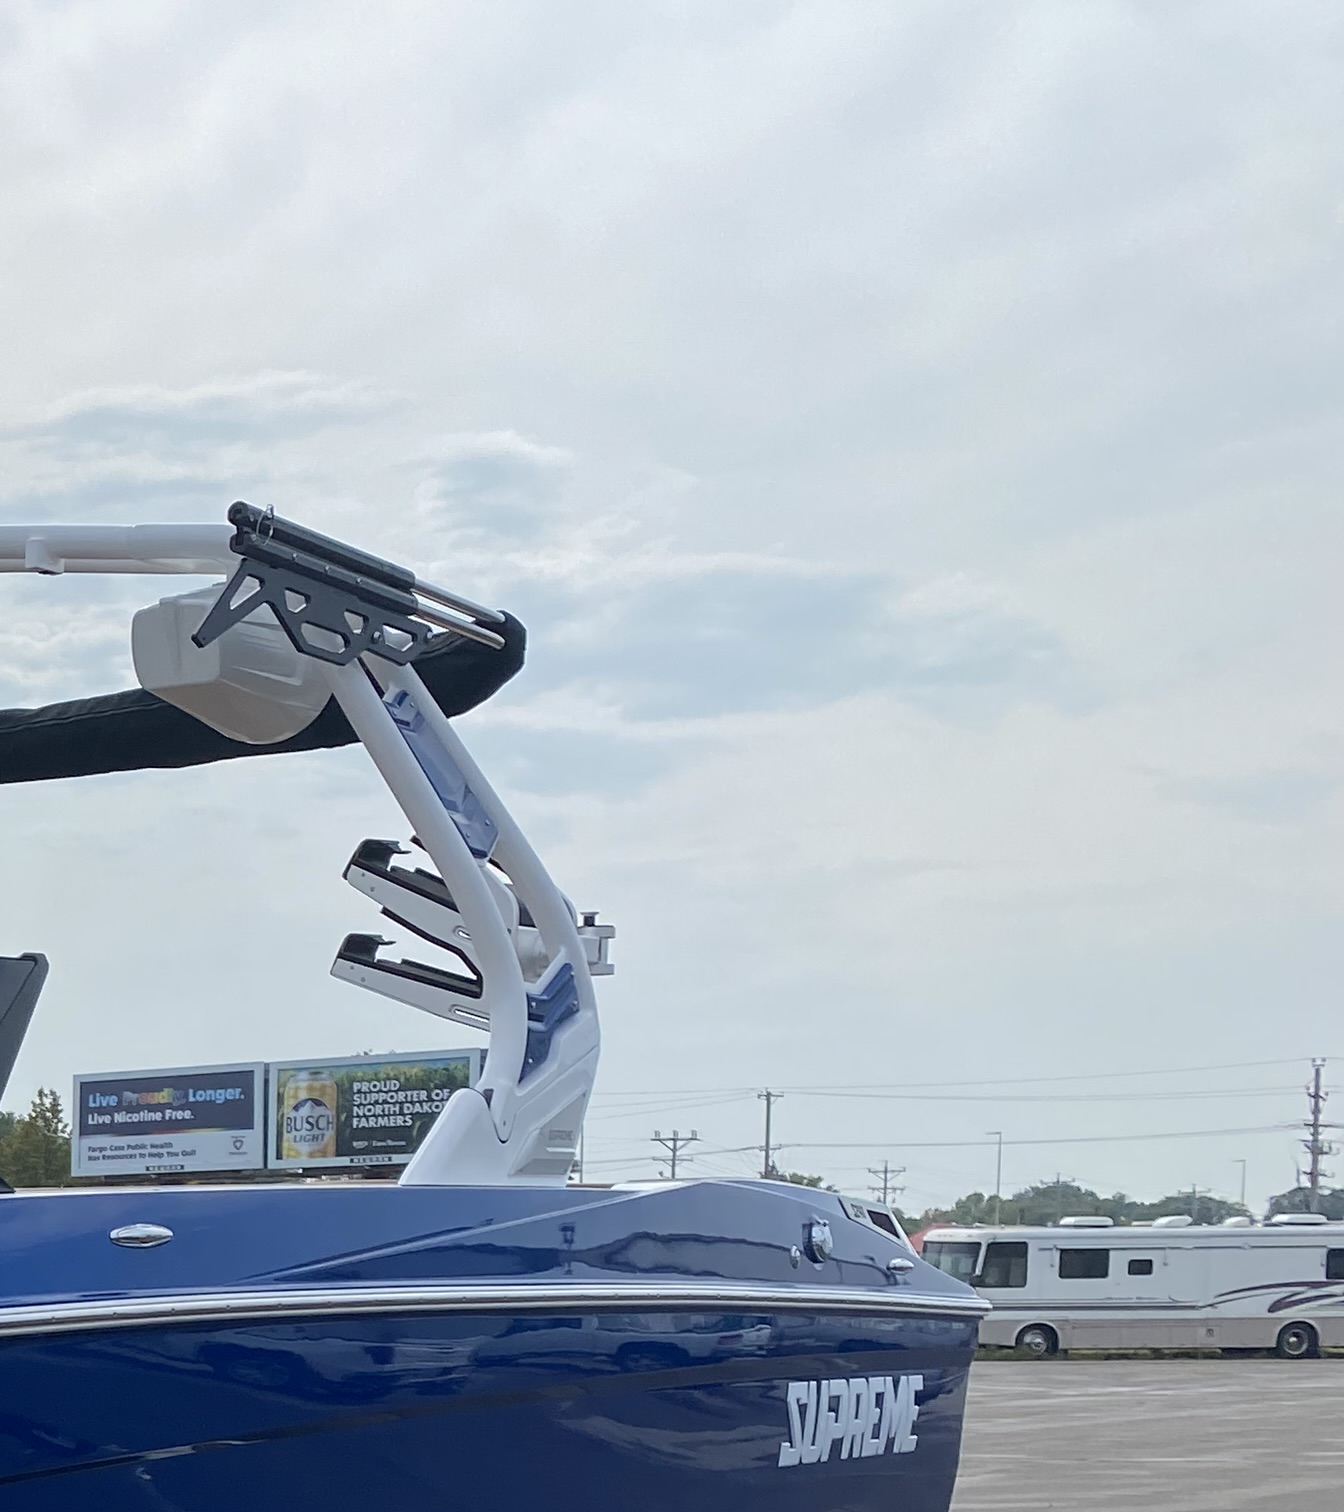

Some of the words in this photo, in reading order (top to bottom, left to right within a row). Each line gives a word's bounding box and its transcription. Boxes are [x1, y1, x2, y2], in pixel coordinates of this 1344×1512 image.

[353, 1080, 400, 1093] PROUD
[88, 1093, 118, 1107] Live
[188, 1087, 245, 1104] Longer.
[353, 1090, 428, 1104] SUPPORTER
[431, 1088, 450, 1101] OF
[353, 1104, 400, 1116] NORTH
[403, 1101, 449, 1114] DAKO
[88, 1113, 111, 1125] Live
[114, 1110, 162, 1123] Nicotine
[165, 1109, 195, 1121] Free.
[286, 1114, 334, 1134] BUSCH
[353, 1115, 413, 1128] FARMERS
[293, 1133, 326, 1143] LIGHT
[181, 1149, 196, 1157] Quit
[778, 1374, 924, 1468] SUPREME
